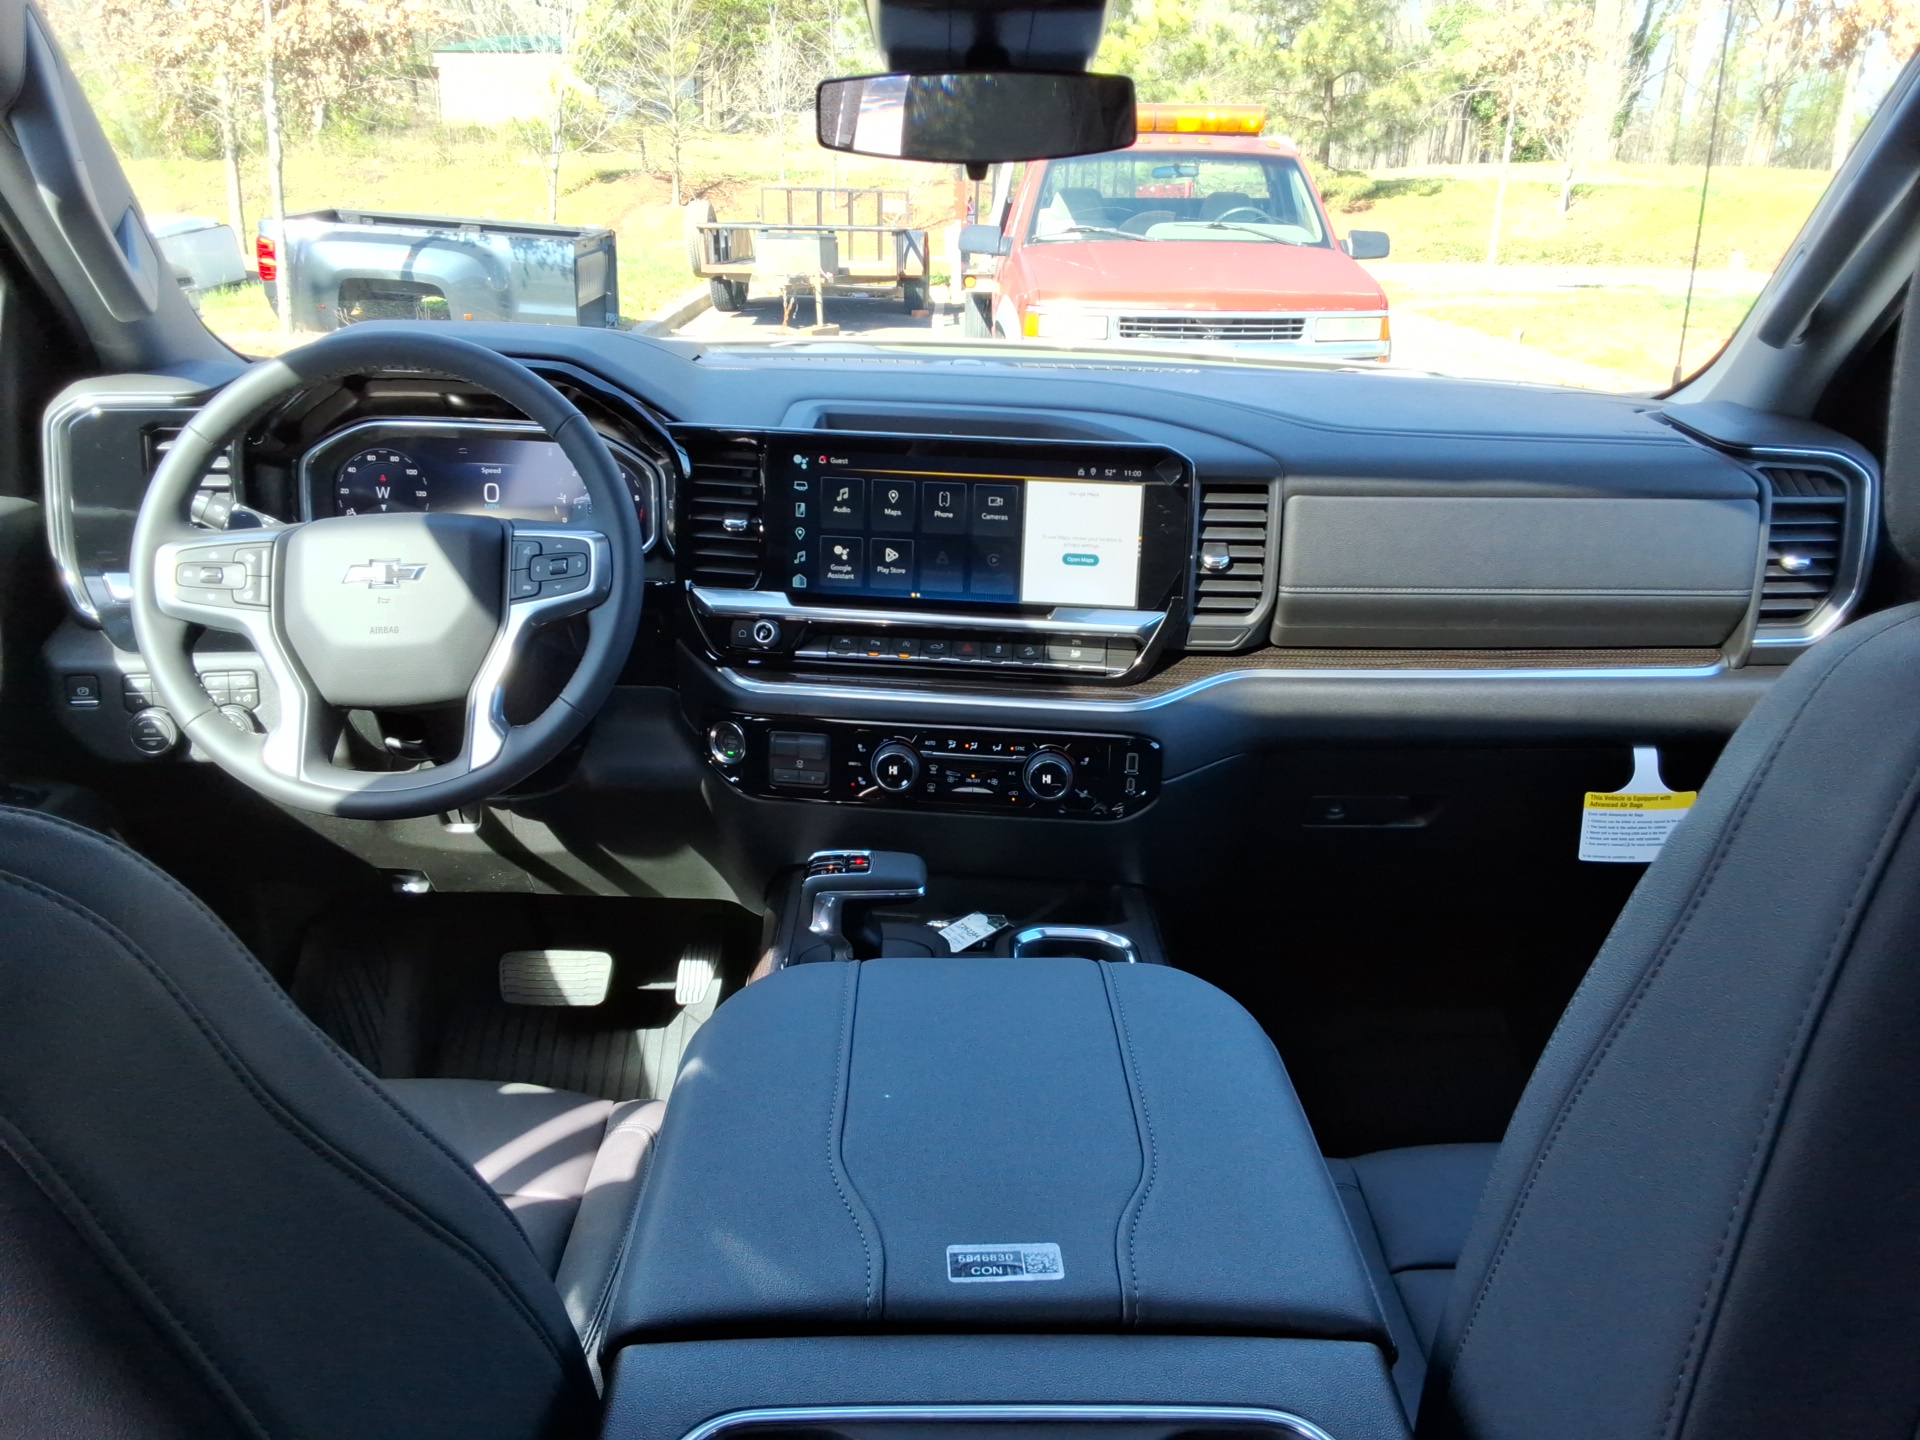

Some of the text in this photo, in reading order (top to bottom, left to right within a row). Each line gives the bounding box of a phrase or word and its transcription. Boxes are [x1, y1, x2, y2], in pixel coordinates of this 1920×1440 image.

[830, 457, 848, 465] Guest
[375, 486, 390, 499] W
[483, 483, 500, 503] 0
[884, 508, 902, 516] Maps
[934, 510, 953, 518] Phone
[981, 512, 1008, 521] Cameras
[830, 563, 852, 573] Google
[877, 566, 906, 574] Play Store
[827, 572, 854, 580] Assistant
[369, 626, 399, 635] AIRBAG
[888, 766, 898, 775] HI
[1042, 774, 1051, 784] HI
[971, 1266, 1003, 1275] CON
